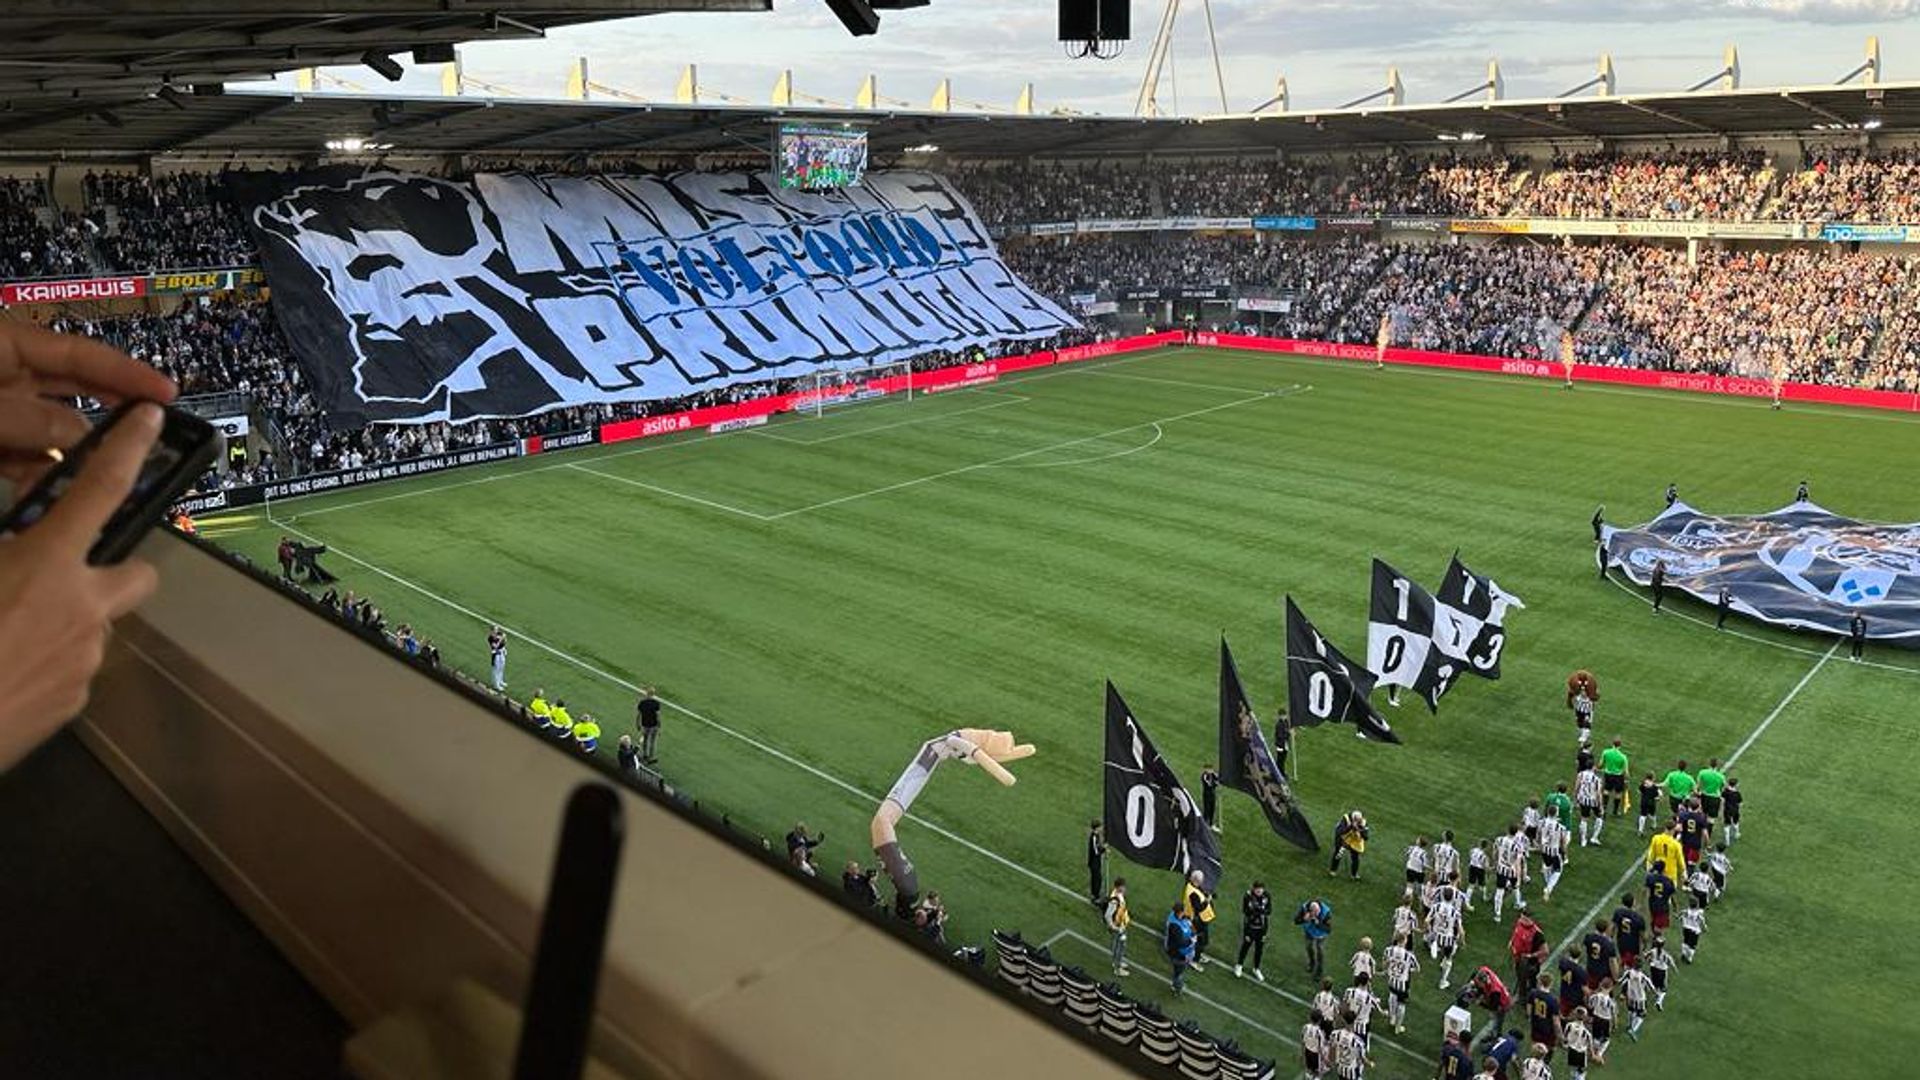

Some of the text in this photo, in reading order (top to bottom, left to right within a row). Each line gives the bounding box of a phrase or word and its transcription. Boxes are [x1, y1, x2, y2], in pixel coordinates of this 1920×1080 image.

[16, 281, 136, 302] KAMPHUIS
[1502, 359, 1534, 374] asito
[1661, 374, 1711, 389] samen
[1713, 378, 1726, 393] &
[642, 416, 677, 435] asito
[290, 481, 311, 494] ONZE
[1393, 578, 1410, 621] 1
[1382, 635, 1406, 674] 0
[1473, 634, 1504, 670] 3
[1308, 670, 1334, 719] 0
[1125, 784, 1155, 849] 0
[1687, 818, 1697, 833] 9
[1653, 883, 1664, 897] 2
[1621, 918, 1632, 933] 5
[1562, 970, 1573, 985] 4
[1534, 998, 1547, 1019] 10
